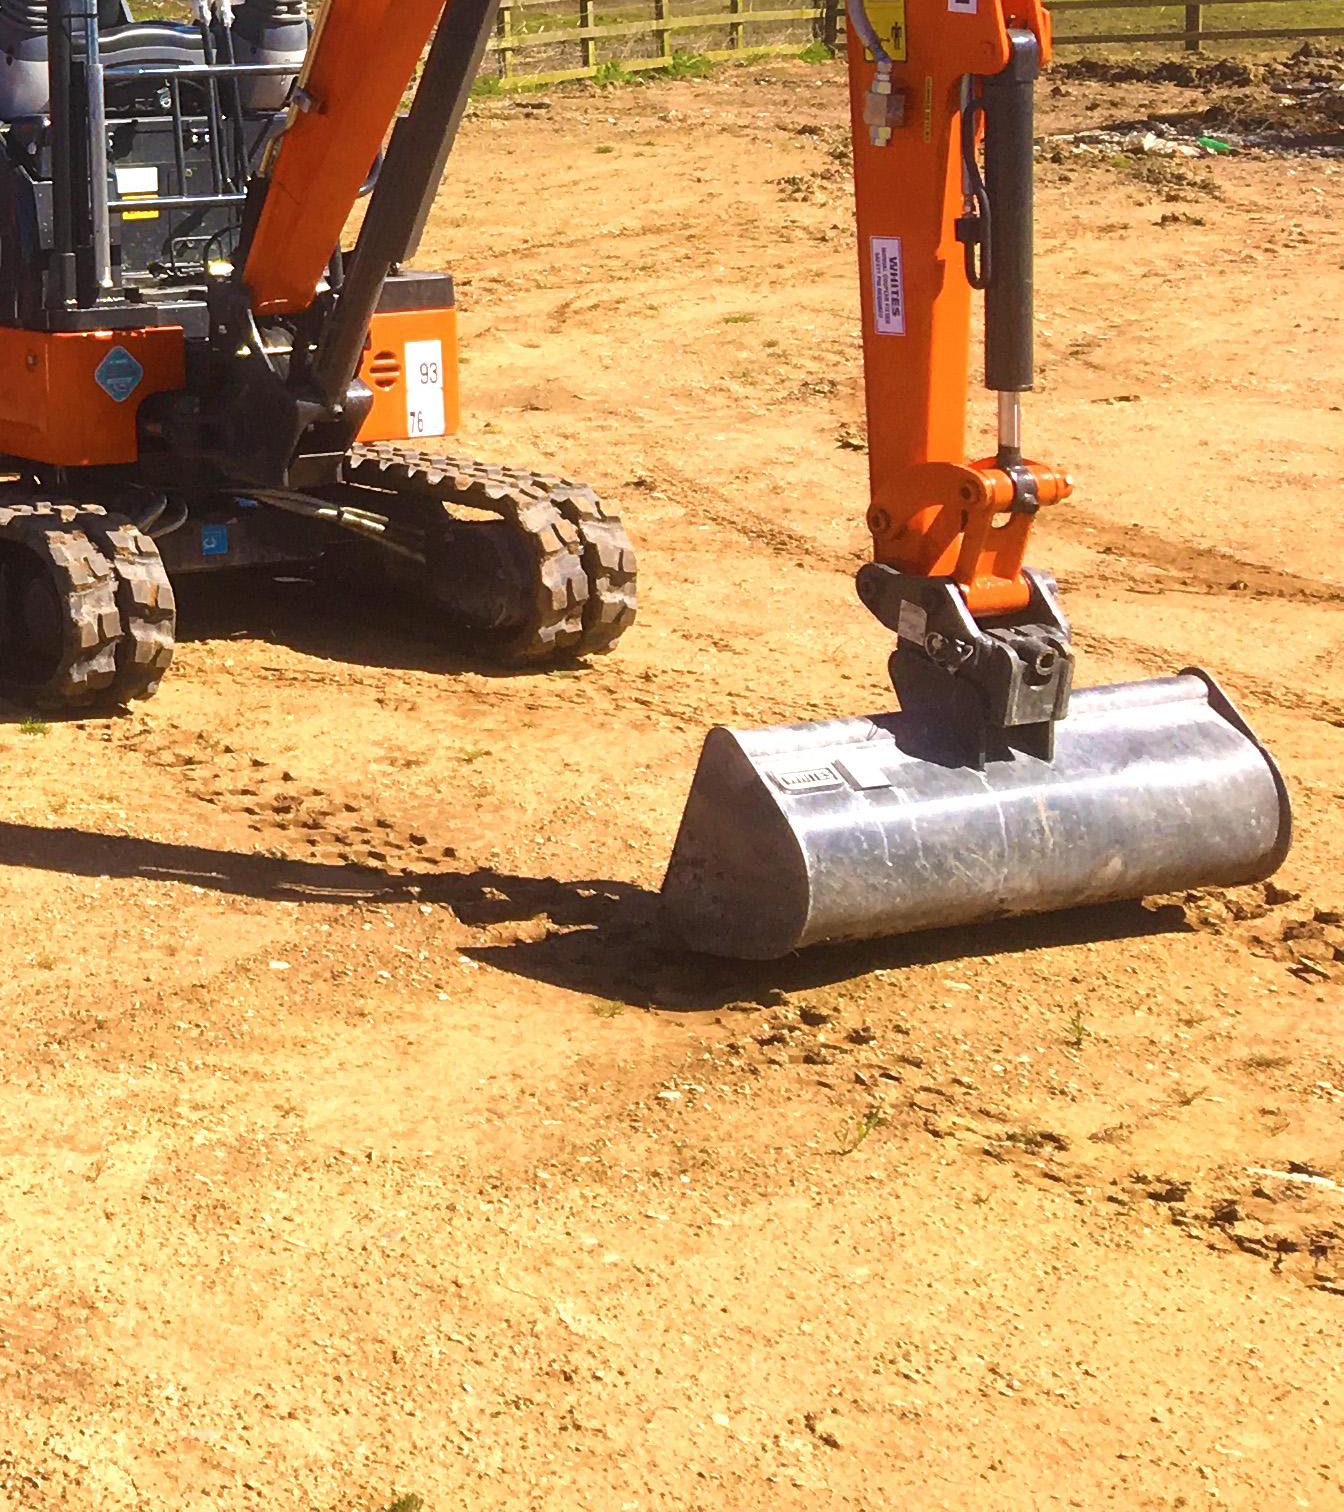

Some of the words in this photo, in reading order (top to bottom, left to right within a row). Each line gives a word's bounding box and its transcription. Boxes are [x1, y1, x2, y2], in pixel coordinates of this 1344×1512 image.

[889, 256, 901, 317] WHITES
[419, 362, 438, 385] 93
[409, 410, 424, 434] 76
